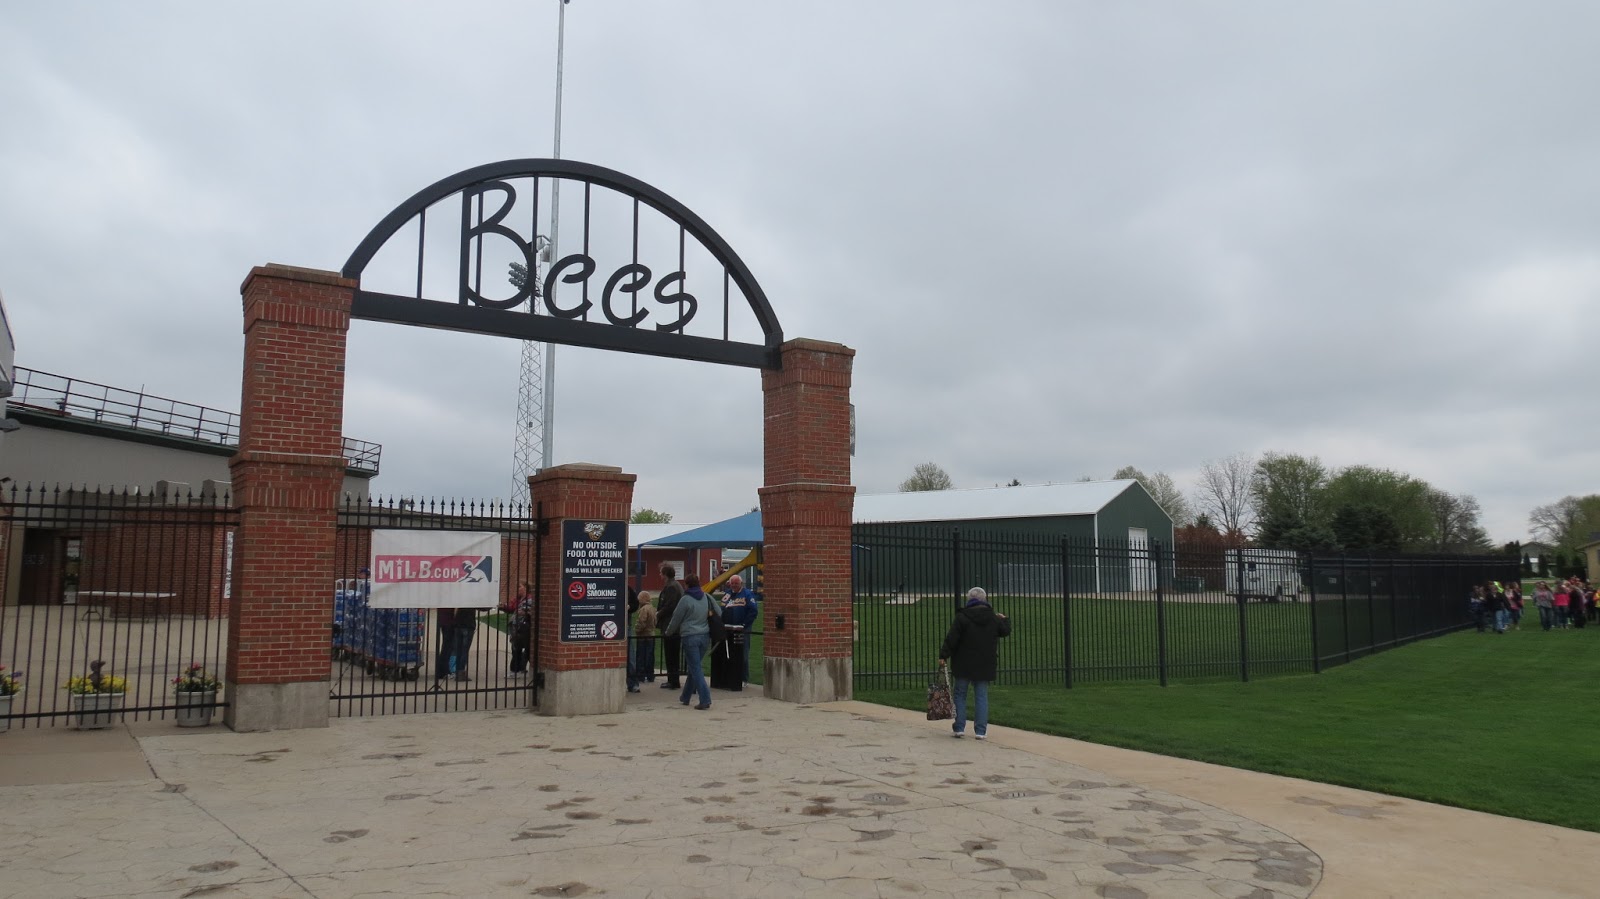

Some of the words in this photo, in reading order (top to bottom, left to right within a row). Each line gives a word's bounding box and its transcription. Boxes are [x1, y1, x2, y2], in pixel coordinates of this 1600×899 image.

[458, 180, 698, 334] Bees
[572, 541, 584, 549] NO
[586, 541, 617, 550] OUTSIDE
[566, 549, 587, 558] FOOD
[588, 550, 599, 558] OR
[600, 550, 623, 558] DRINK
[577, 558, 612, 567] ALLOWED
[586, 582, 597, 590] NO
[586, 589, 617, 597] SMOKING
